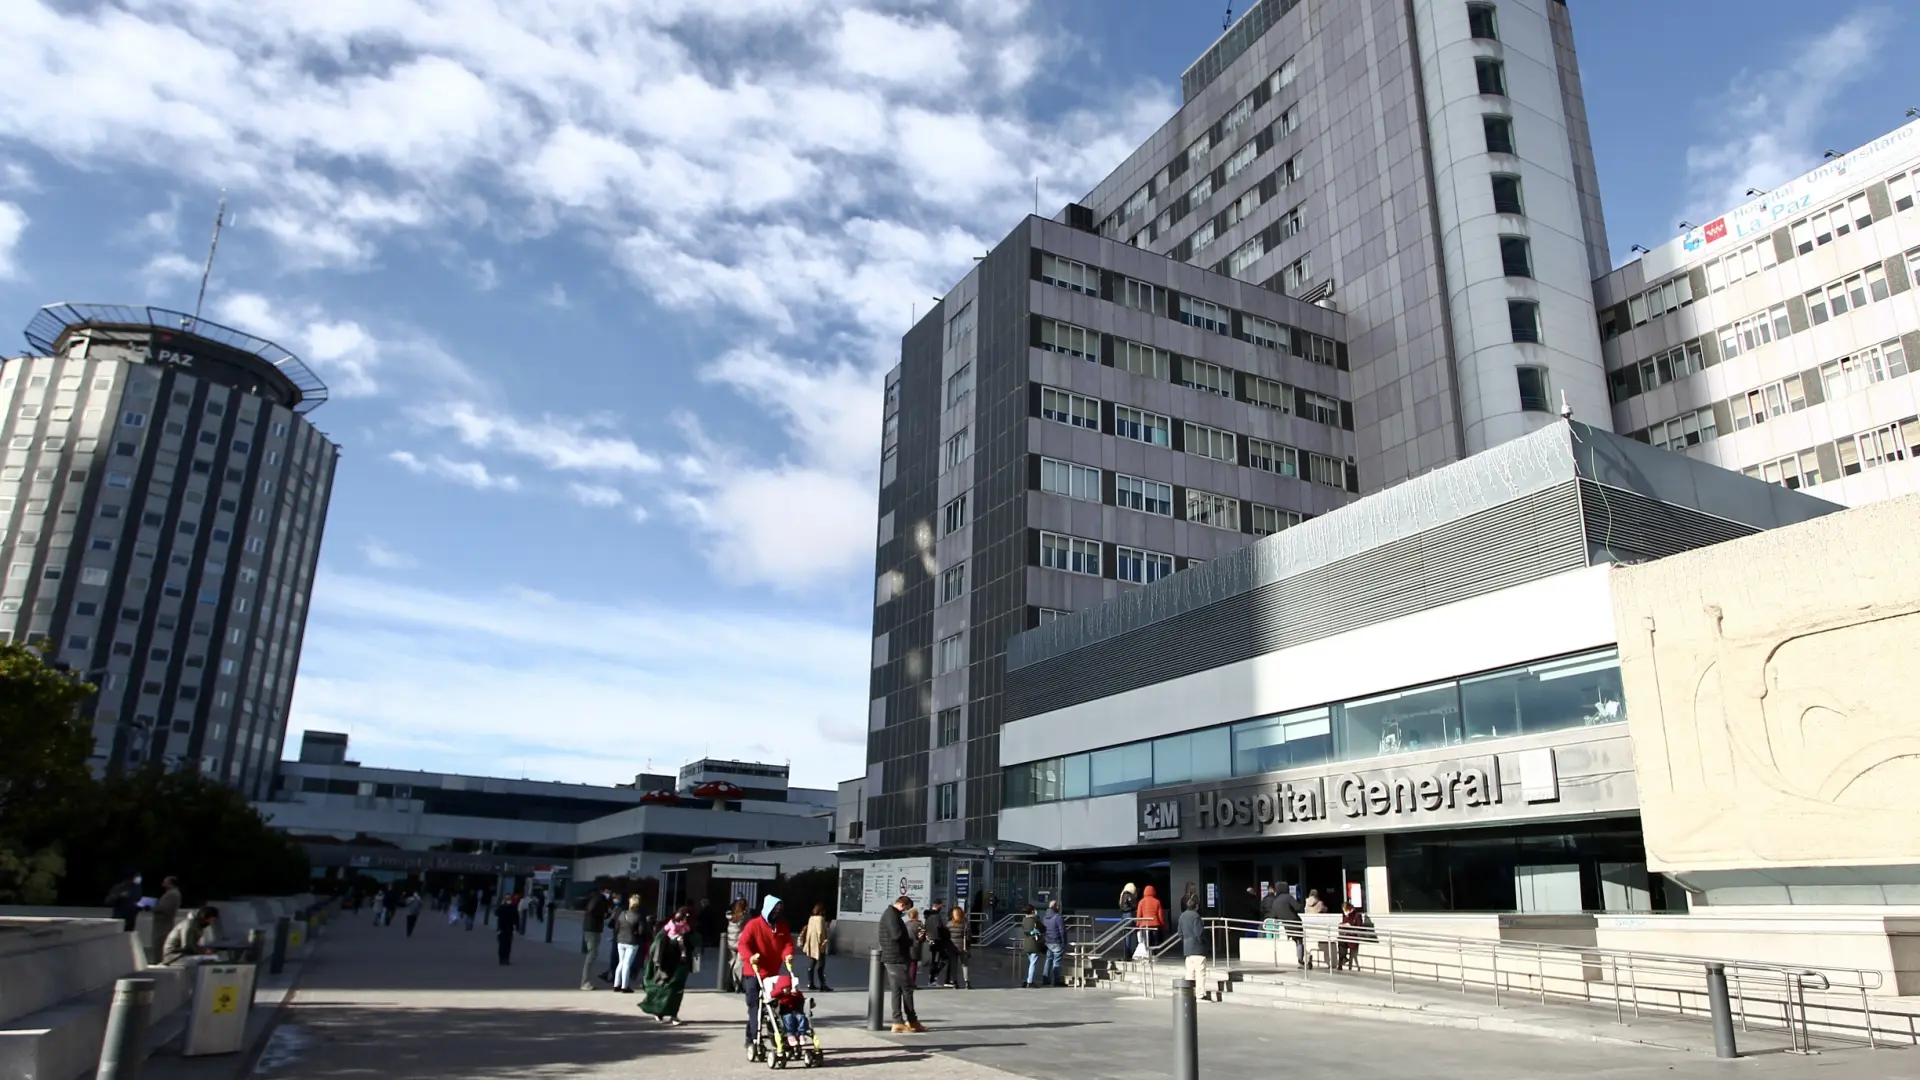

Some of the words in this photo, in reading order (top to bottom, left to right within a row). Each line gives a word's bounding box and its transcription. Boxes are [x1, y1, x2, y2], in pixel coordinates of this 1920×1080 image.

[1806, 126, 1914, 184] Universitario
[1736, 218, 1762, 239] La
[1771, 194, 1811, 222] Paz
[157, 349, 194, 367] PAZ
[1194, 776, 1327, 834] Hospital
[1335, 754, 1503, 818] General
